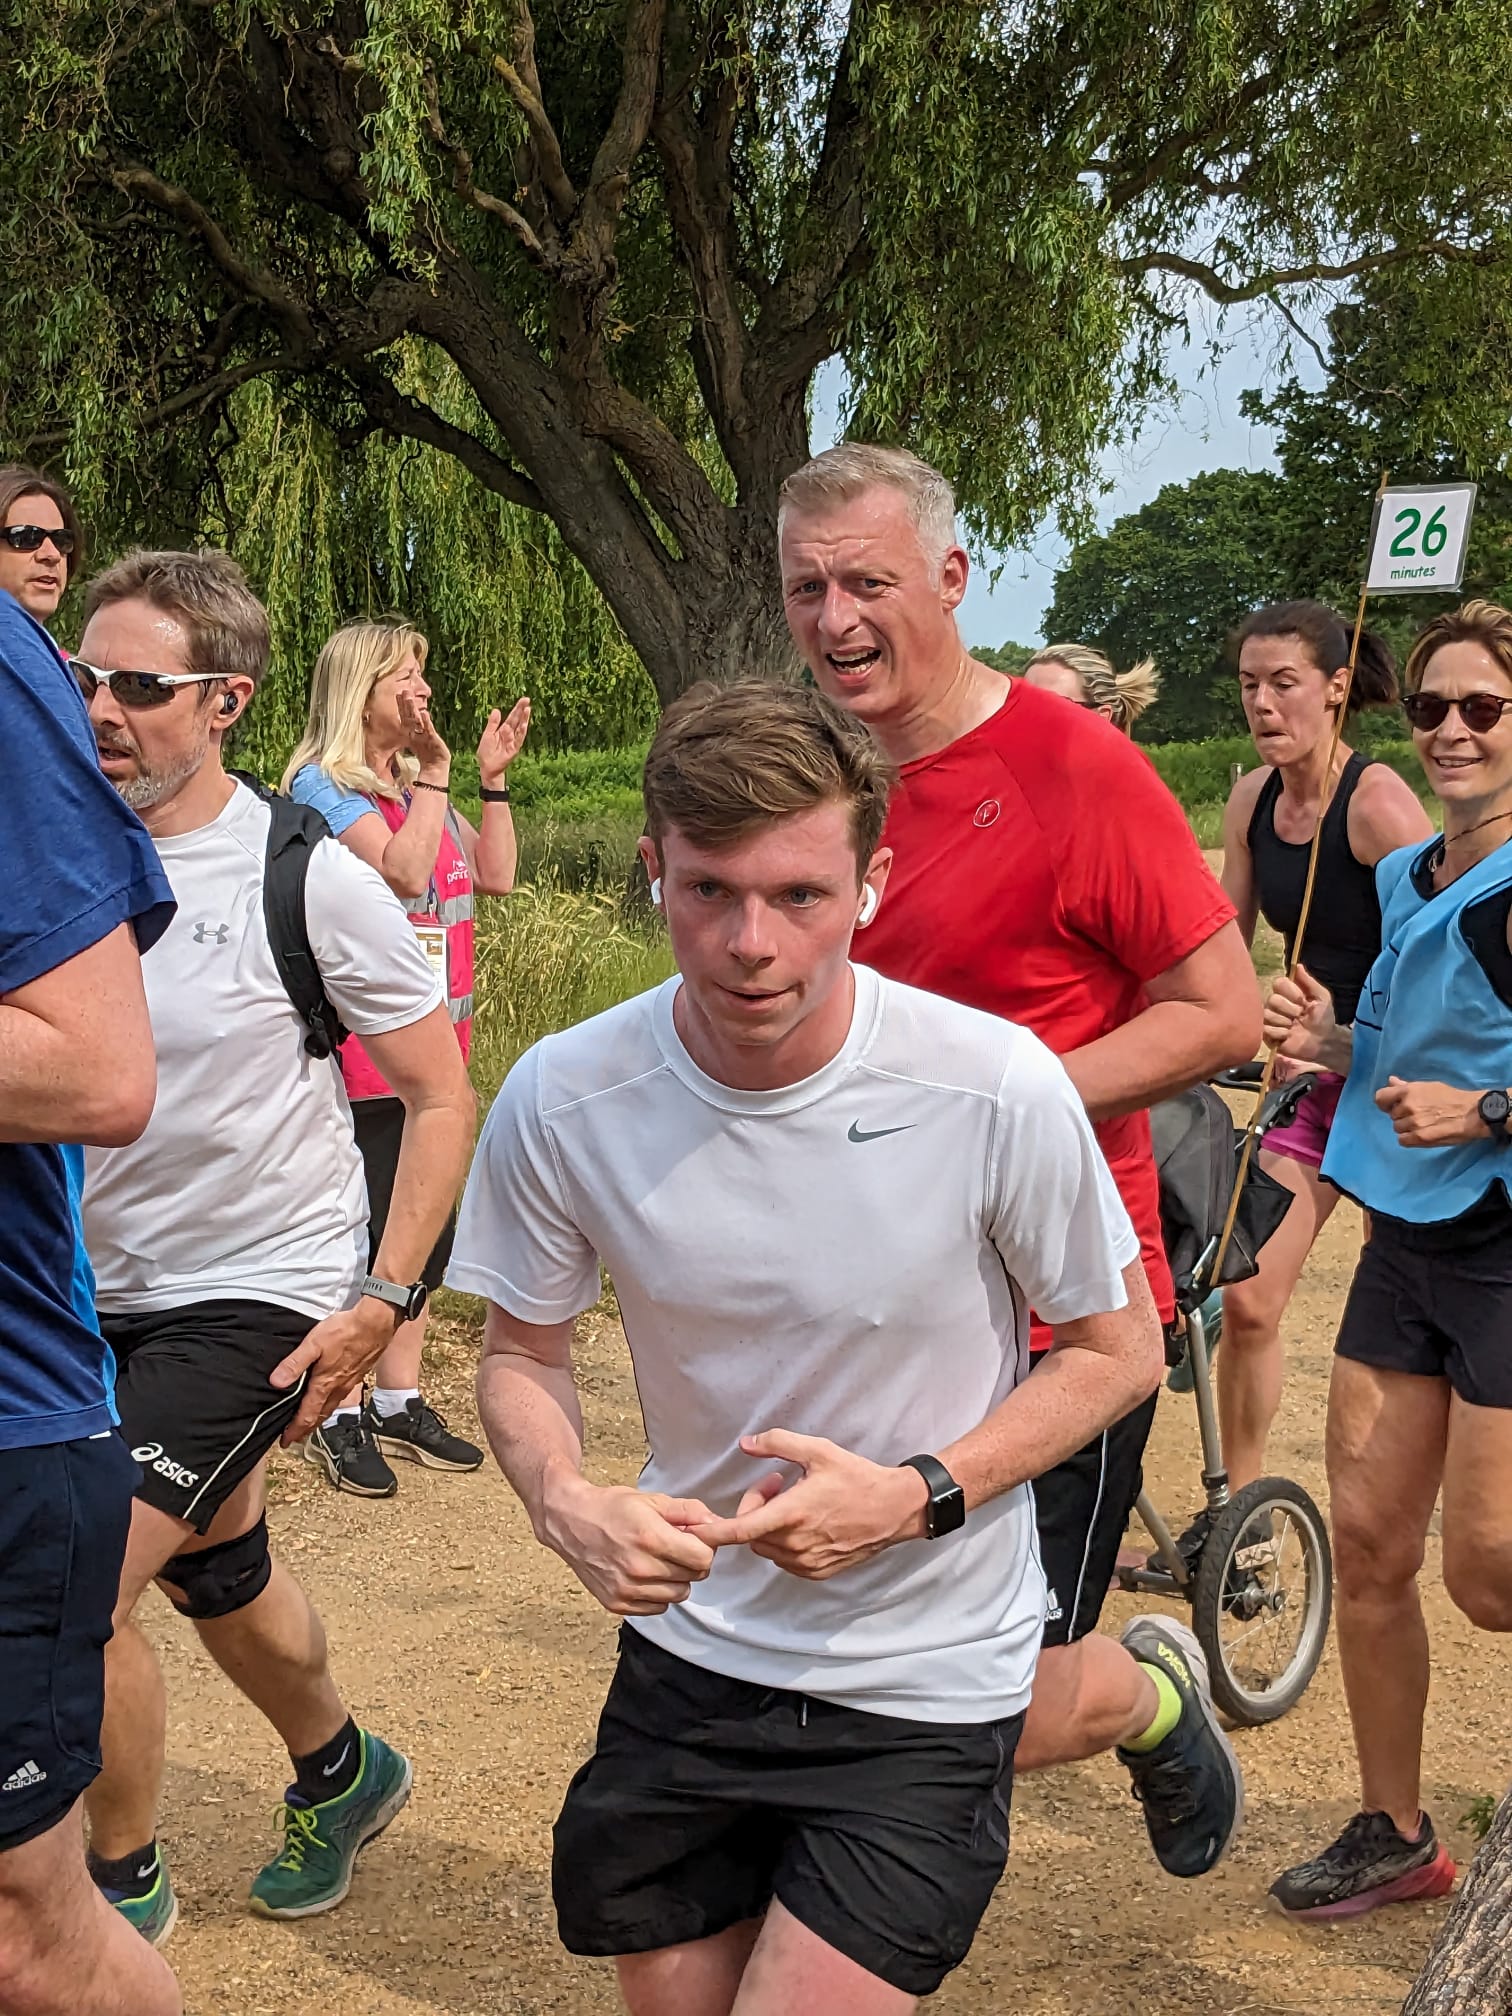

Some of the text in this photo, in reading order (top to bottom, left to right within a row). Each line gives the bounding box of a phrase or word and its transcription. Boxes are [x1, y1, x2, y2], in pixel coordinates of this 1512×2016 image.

[1389, 505, 1447, 557] 26
[1390, 566, 1436, 579] minutes
[152, 1456, 199, 1488] asics
[2, 1771, 47, 1791] adidas
